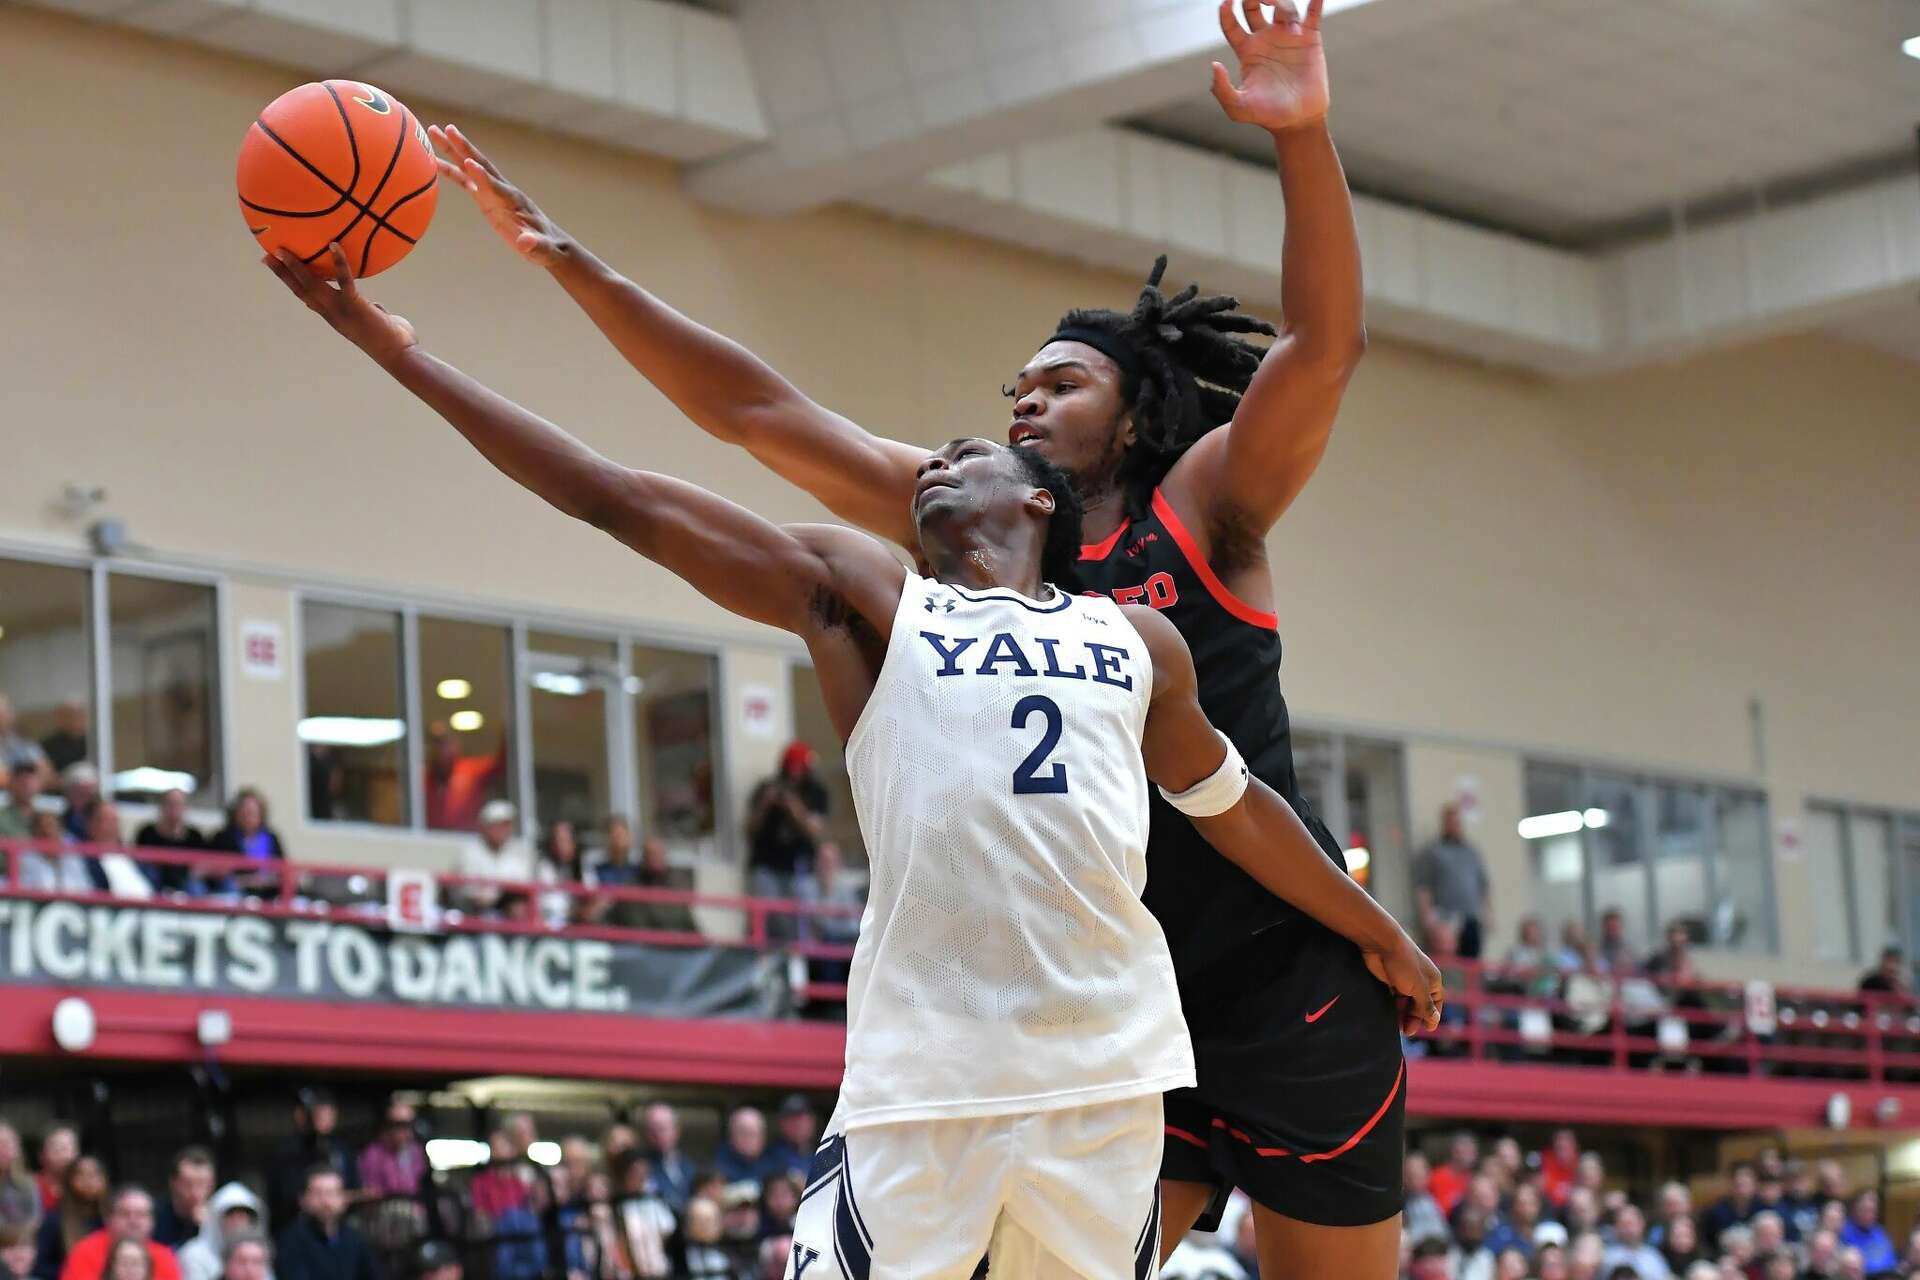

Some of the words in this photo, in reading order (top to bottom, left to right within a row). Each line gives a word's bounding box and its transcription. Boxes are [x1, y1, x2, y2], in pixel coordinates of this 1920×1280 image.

[1083, 571, 1179, 609] ED
[919, 630, 1134, 692] YALE
[1011, 694, 1068, 793] 2
[0, 900, 278, 992] ICKETS
[285, 918, 382, 998] TO
[390, 934, 631, 1012] DANCE.
[793, 1240, 821, 1280] Y
